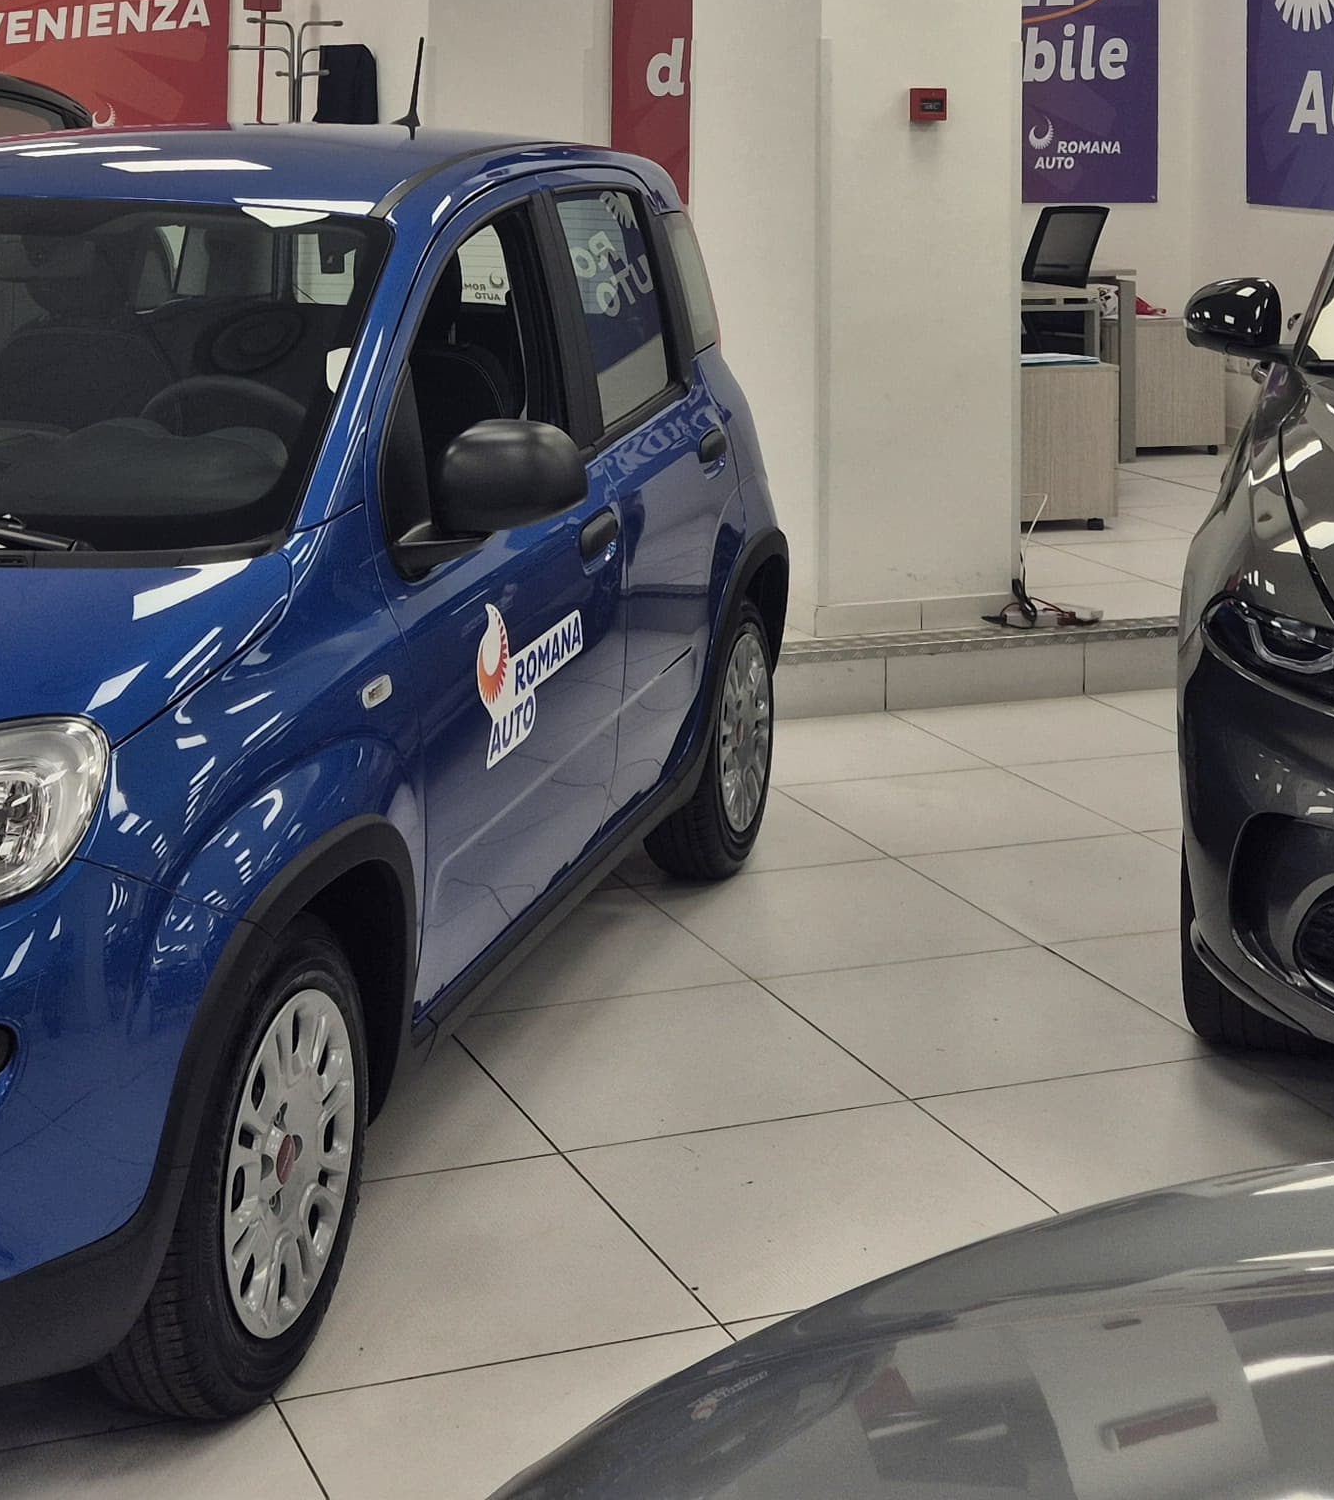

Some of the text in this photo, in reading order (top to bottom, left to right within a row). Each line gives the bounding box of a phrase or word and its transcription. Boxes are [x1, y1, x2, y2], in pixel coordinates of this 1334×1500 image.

[1023, 23, 1129, 82] bile
[1034, 156, 1075, 170] AUTO
[1057, 140, 1121, 155] ROMANA
[515, 616, 582, 696] ROMANA
[489, 695, 534, 761] AUTO
